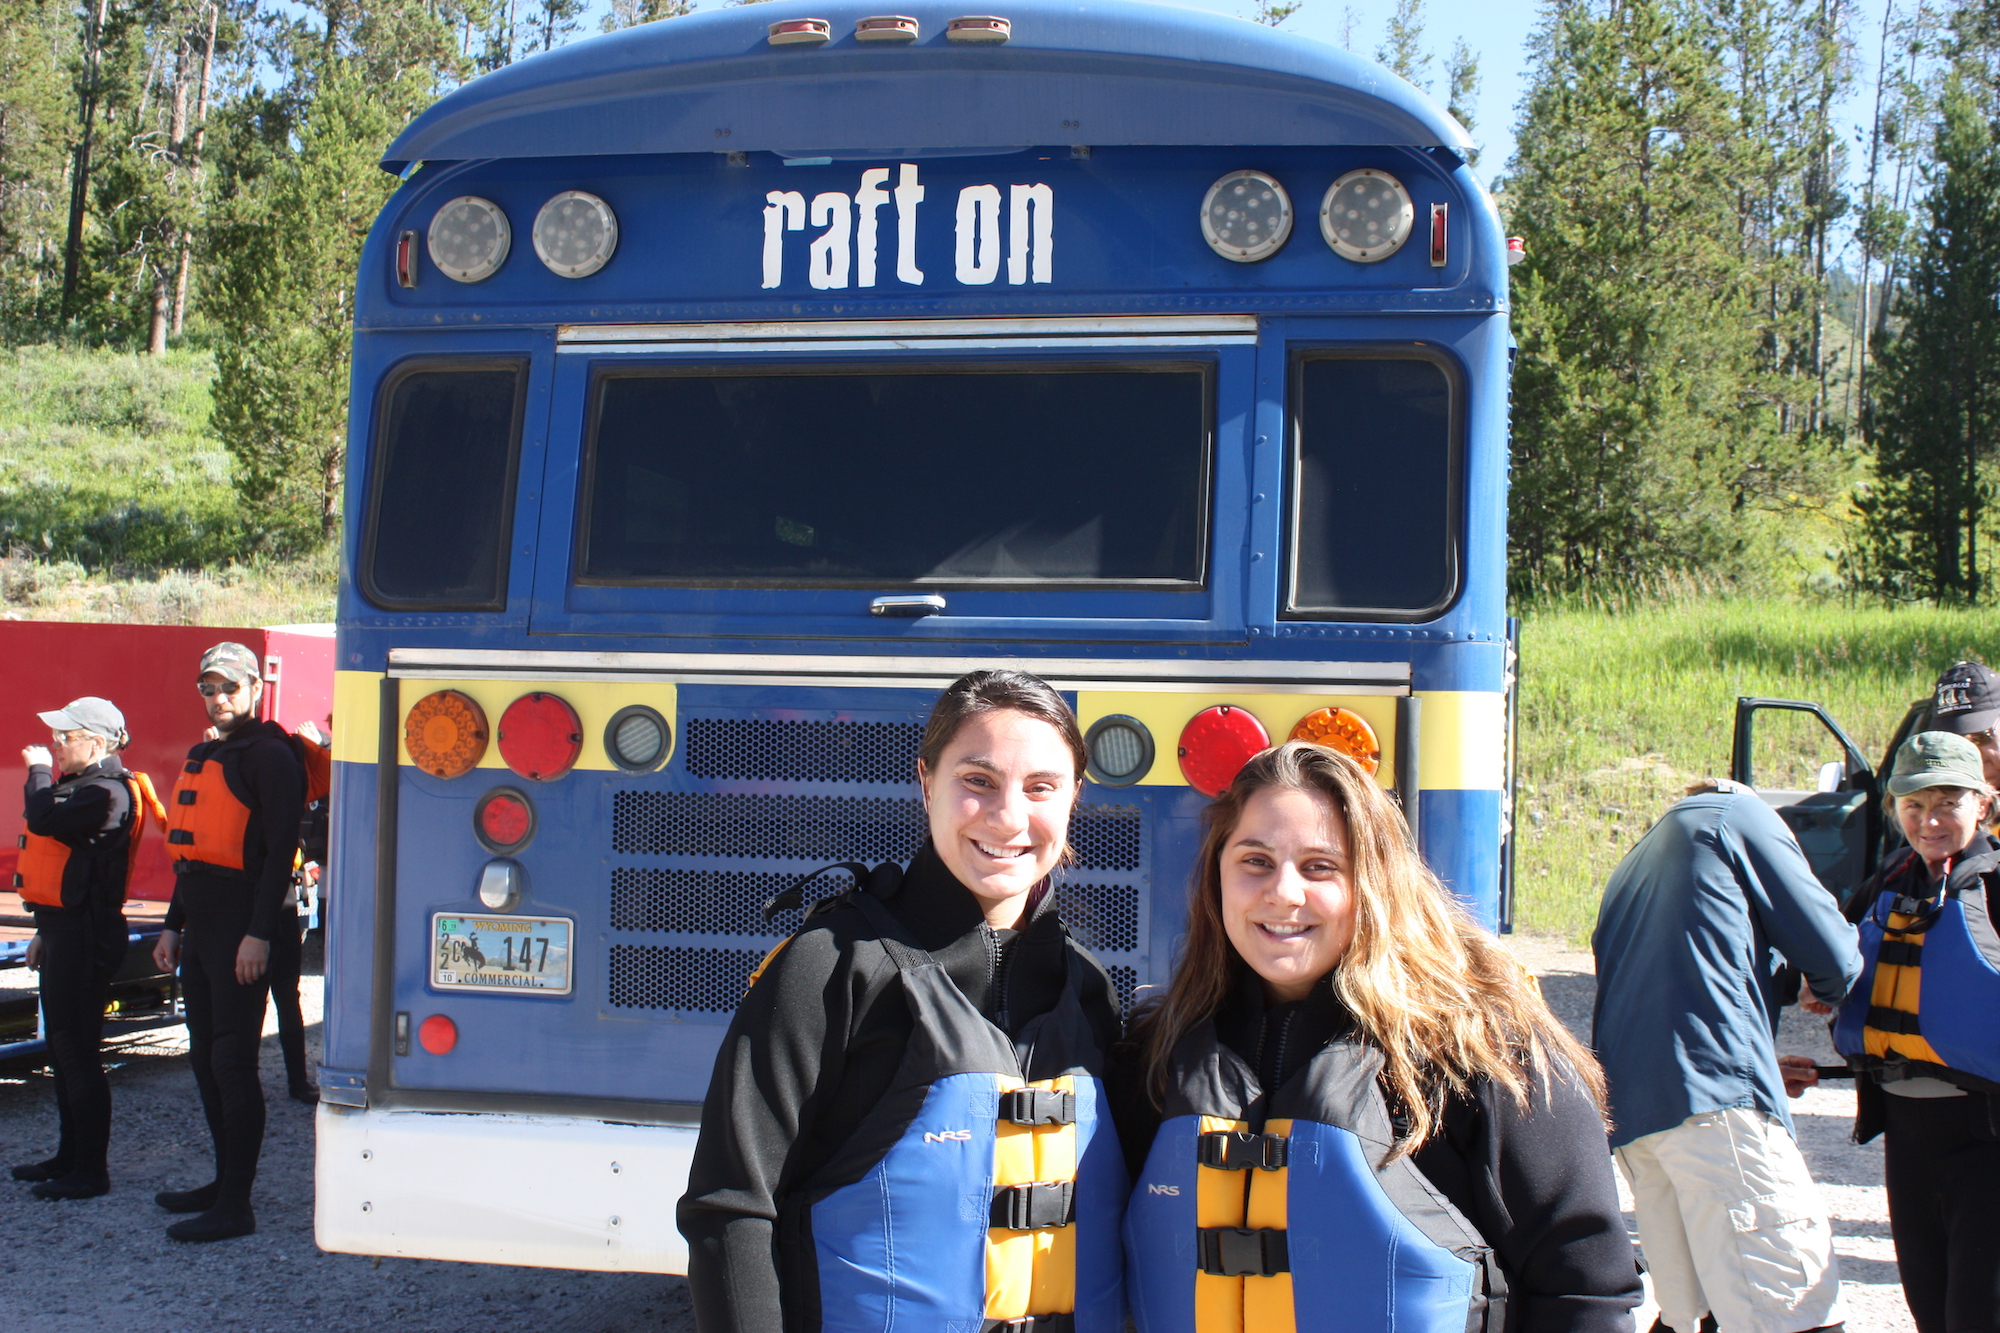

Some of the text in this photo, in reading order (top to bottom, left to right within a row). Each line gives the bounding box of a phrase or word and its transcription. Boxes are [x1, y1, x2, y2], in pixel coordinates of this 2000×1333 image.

[761, 163, 1054, 290] raft on
[473, 921, 532, 933] WYOMING
[502, 936, 549, 973] 147
[443, 974, 453, 982] 10
[464, 972, 538, 987] COMMERCIAL
[923, 1129, 972, 1143] NRS
[1148, 1183, 1180, 1196] NRS
